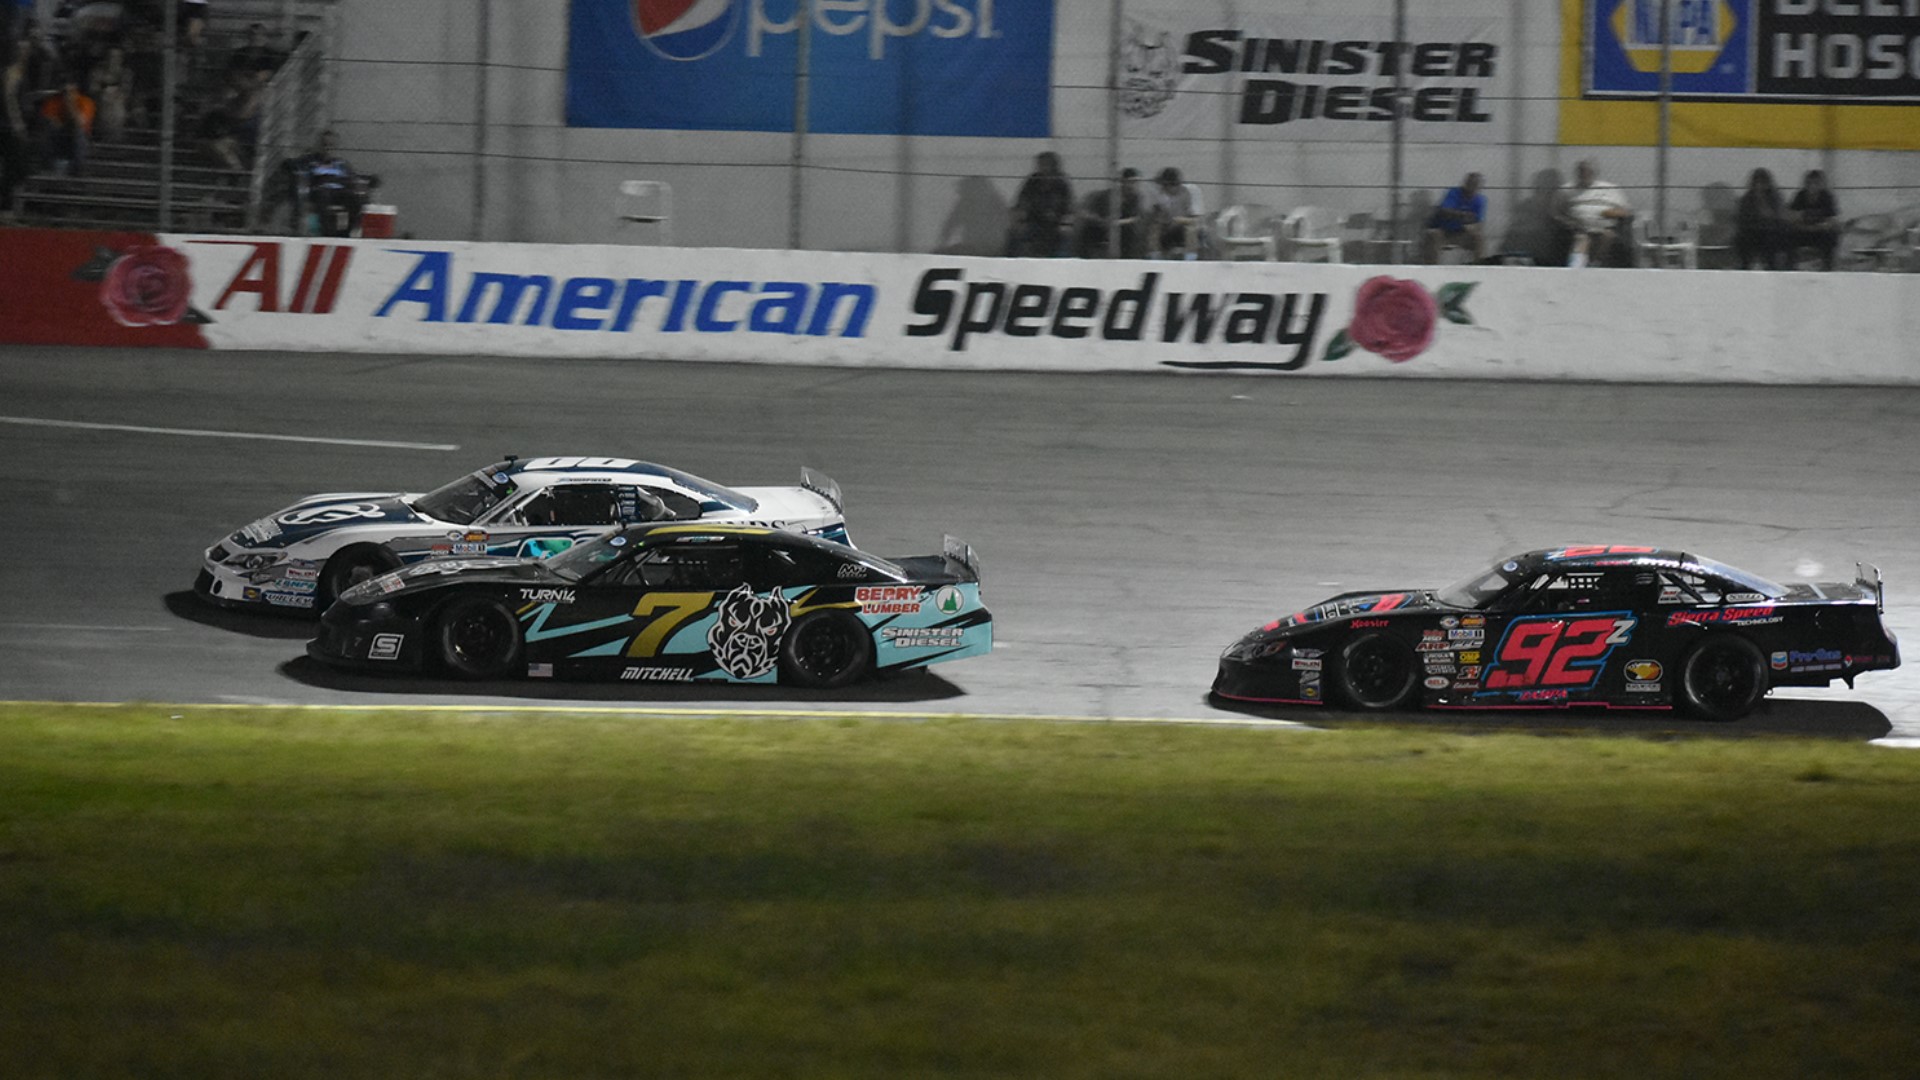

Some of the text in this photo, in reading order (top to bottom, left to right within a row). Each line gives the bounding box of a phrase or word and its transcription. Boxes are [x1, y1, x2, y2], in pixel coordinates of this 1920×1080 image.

[1238, 78, 1493, 125] DIESEL
[186, 239, 1328, 371] All American Speedway
[856, 587, 922, 601] BERRY
[862, 603, 921, 615] LUMBER
[625, 592, 715, 658] 7
[1667, 610, 1721, 626] Sierra
[882, 627, 965, 638] SINISTER
[894, 637, 962, 648] DIESEL
[1485, 618, 1616, 689] 92
[620, 666, 694, 681] MITCHELL
